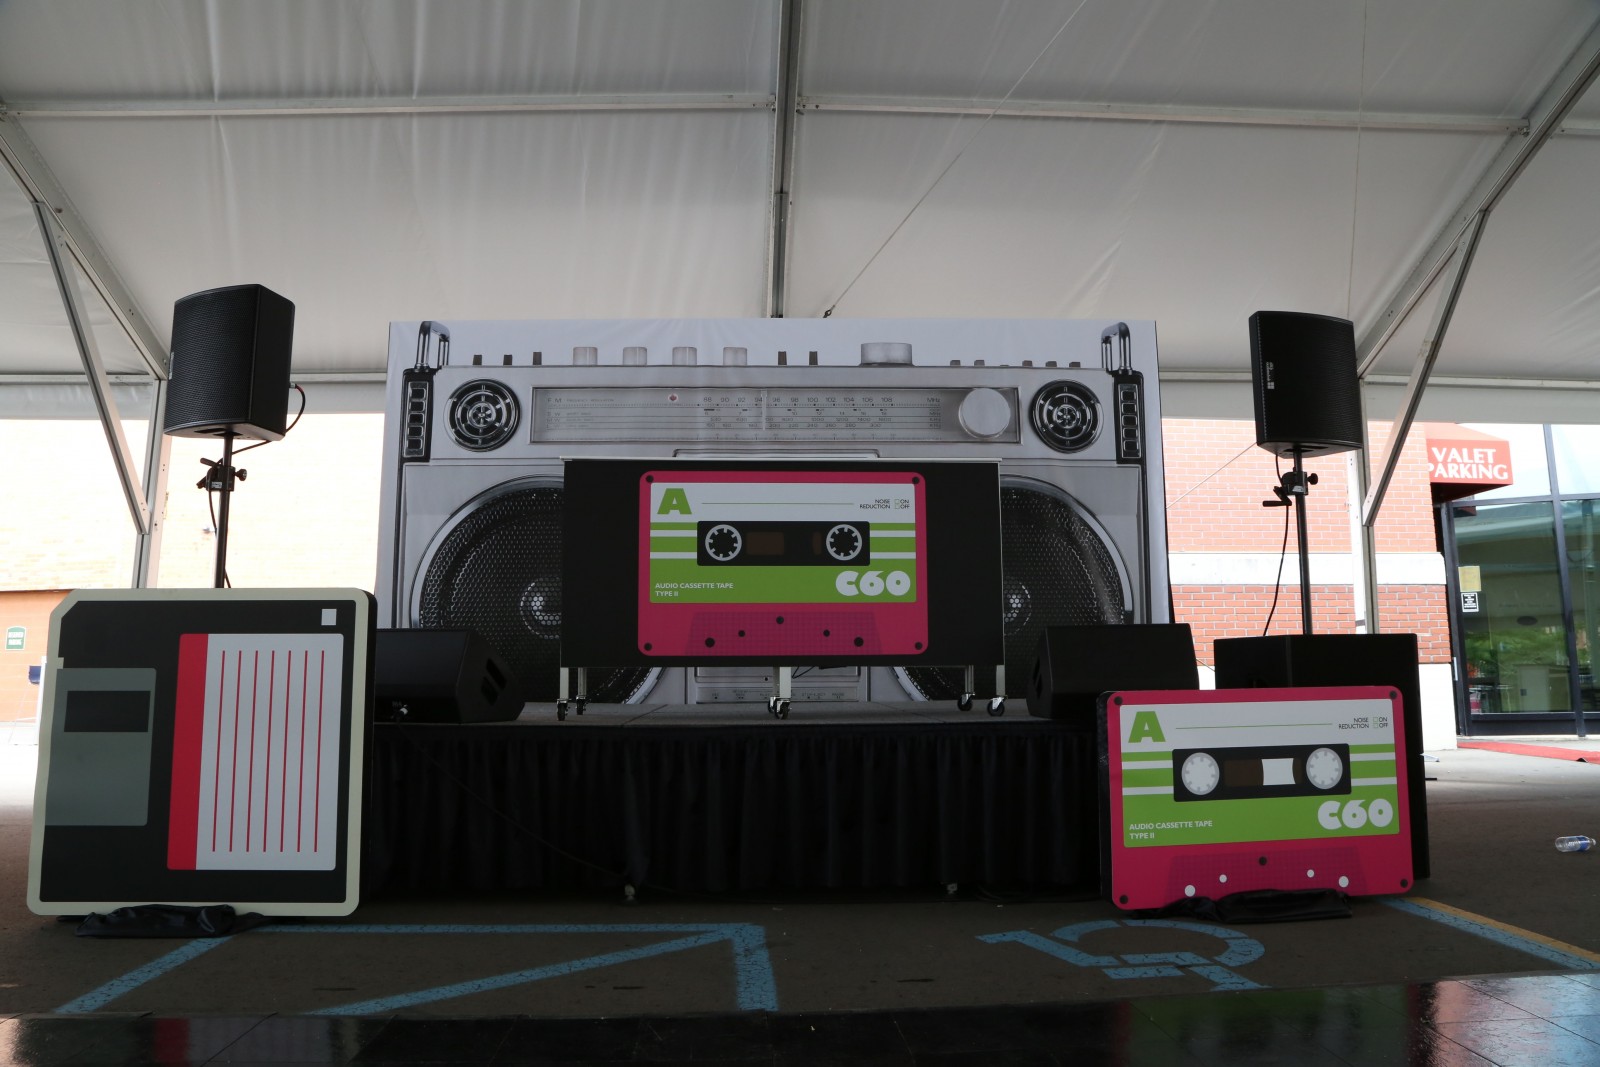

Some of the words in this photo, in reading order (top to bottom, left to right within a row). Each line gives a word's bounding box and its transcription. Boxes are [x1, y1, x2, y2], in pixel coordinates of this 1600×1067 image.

[1431, 447, 1497, 464] VALET
[657, 488, 692, 515] A
[835, 570, 911, 597] C60
[1128, 711, 1166, 744] A
[1129, 822, 1155, 831] AUDIO
[1155, 821, 1193, 829] CASSETTE
[1194, 820, 1213, 828] TAPE
[1317, 798, 1394, 830] C60
[1129, 832, 1149, 840] TYPE
